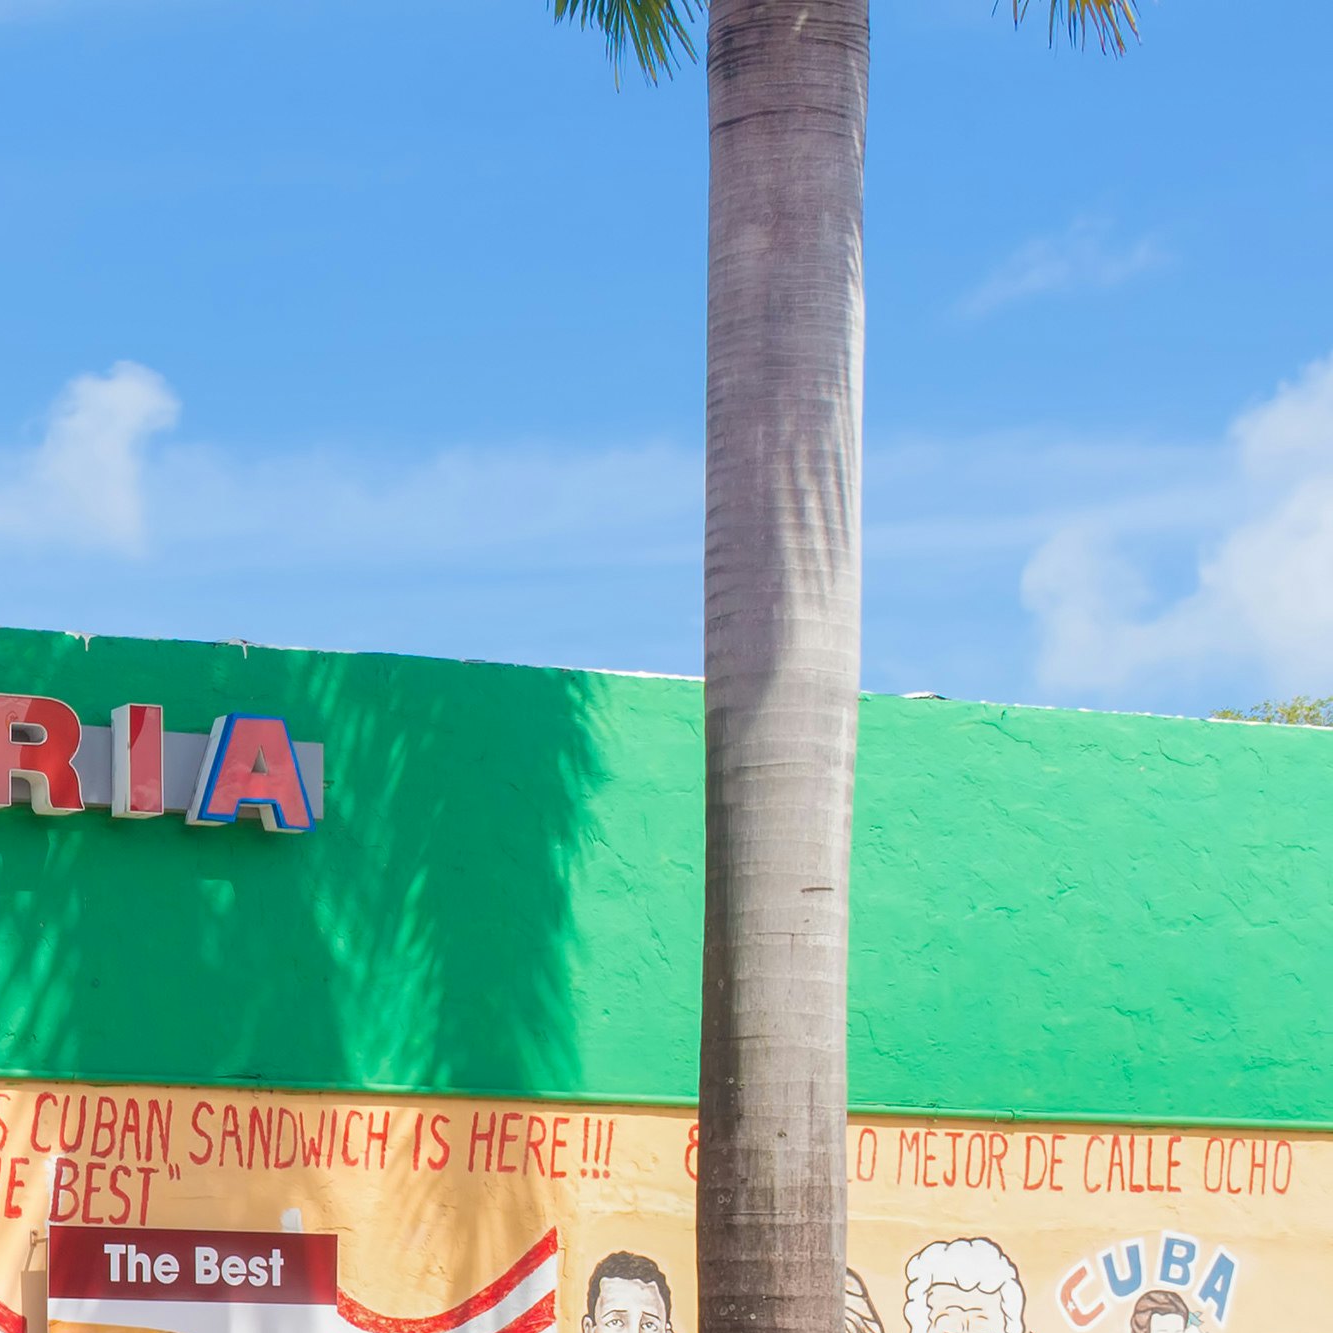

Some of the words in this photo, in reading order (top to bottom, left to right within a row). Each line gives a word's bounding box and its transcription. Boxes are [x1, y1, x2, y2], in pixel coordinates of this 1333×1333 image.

[30, 1091, 174, 1165] CUBAN
[189, 1100, 389, 1172] SANDWICH
[413, 1111, 450, 1172] IS
[897, 1129, 1009, 1191] MEJOR
[1023, 1134, 1065, 1191] DE
[1083, 1134, 1182, 1194] CALLE
[1203, 1137, 1293, 1195] OCHO
[104, 1244, 180, 1284] The
[195, 1246, 284, 1287] Best
[1057, 1233, 1239, 1329] CUBA
